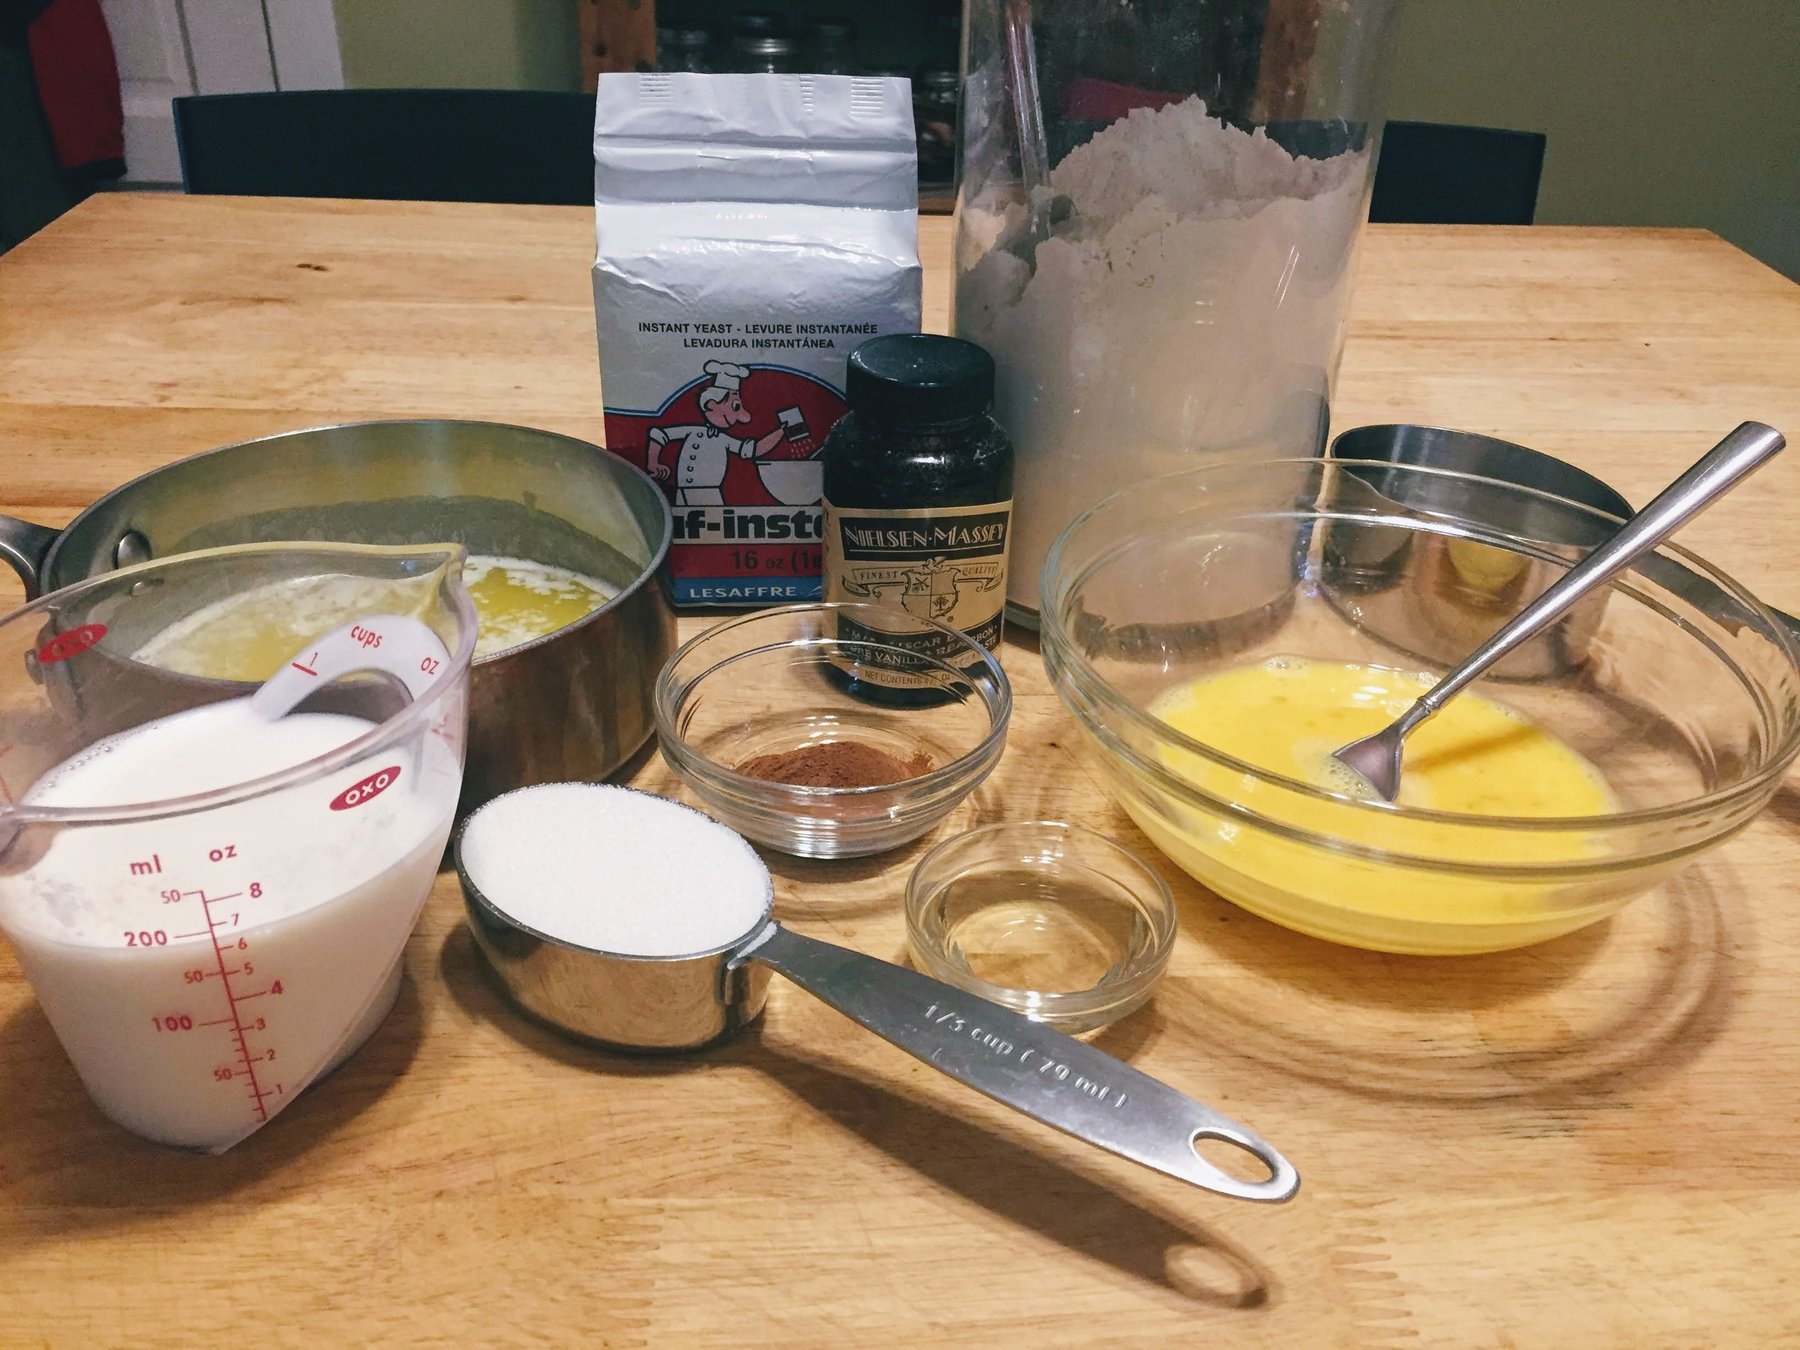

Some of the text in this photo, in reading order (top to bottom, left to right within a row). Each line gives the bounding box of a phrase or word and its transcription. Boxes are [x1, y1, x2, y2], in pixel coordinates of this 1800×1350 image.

[638, 322, 690, 334] INSTANT
[694, 323, 733, 334] YEAST
[745, 325, 793, 335] LEVURE
[796, 322, 878, 335] INSTANTANÉE
[683, 338, 835, 349] LEVADURA INSTANTÁNEA
[731, 551, 759, 570] 16
[859, 570, 898, 581] FINEST
[690, 586, 797, 599] LESAFFRE
[350, 625, 383, 649] cups
[345, 774, 389, 805] OXO
[209, 844, 238, 863] oz
[130, 854, 162, 876] ml
[161, 889, 181, 904] 50
[249, 882, 263, 899] 8
[231, 913, 239, 927] 7
[123, 930, 168, 947] 200
[238, 937, 248, 951] 6
[244, 962, 253, 976] 5
[184, 970, 203, 984] 50
[270, 980, 284, 995] 4
[151, 1015, 193, 1032] 100
[256, 1018, 266, 1031] 3
[971, 1027, 1014, 1056] cup
[266, 1049, 276, 1061] 2
[213, 1068, 232, 1082] 50
[275, 1083, 284, 1095] 1
